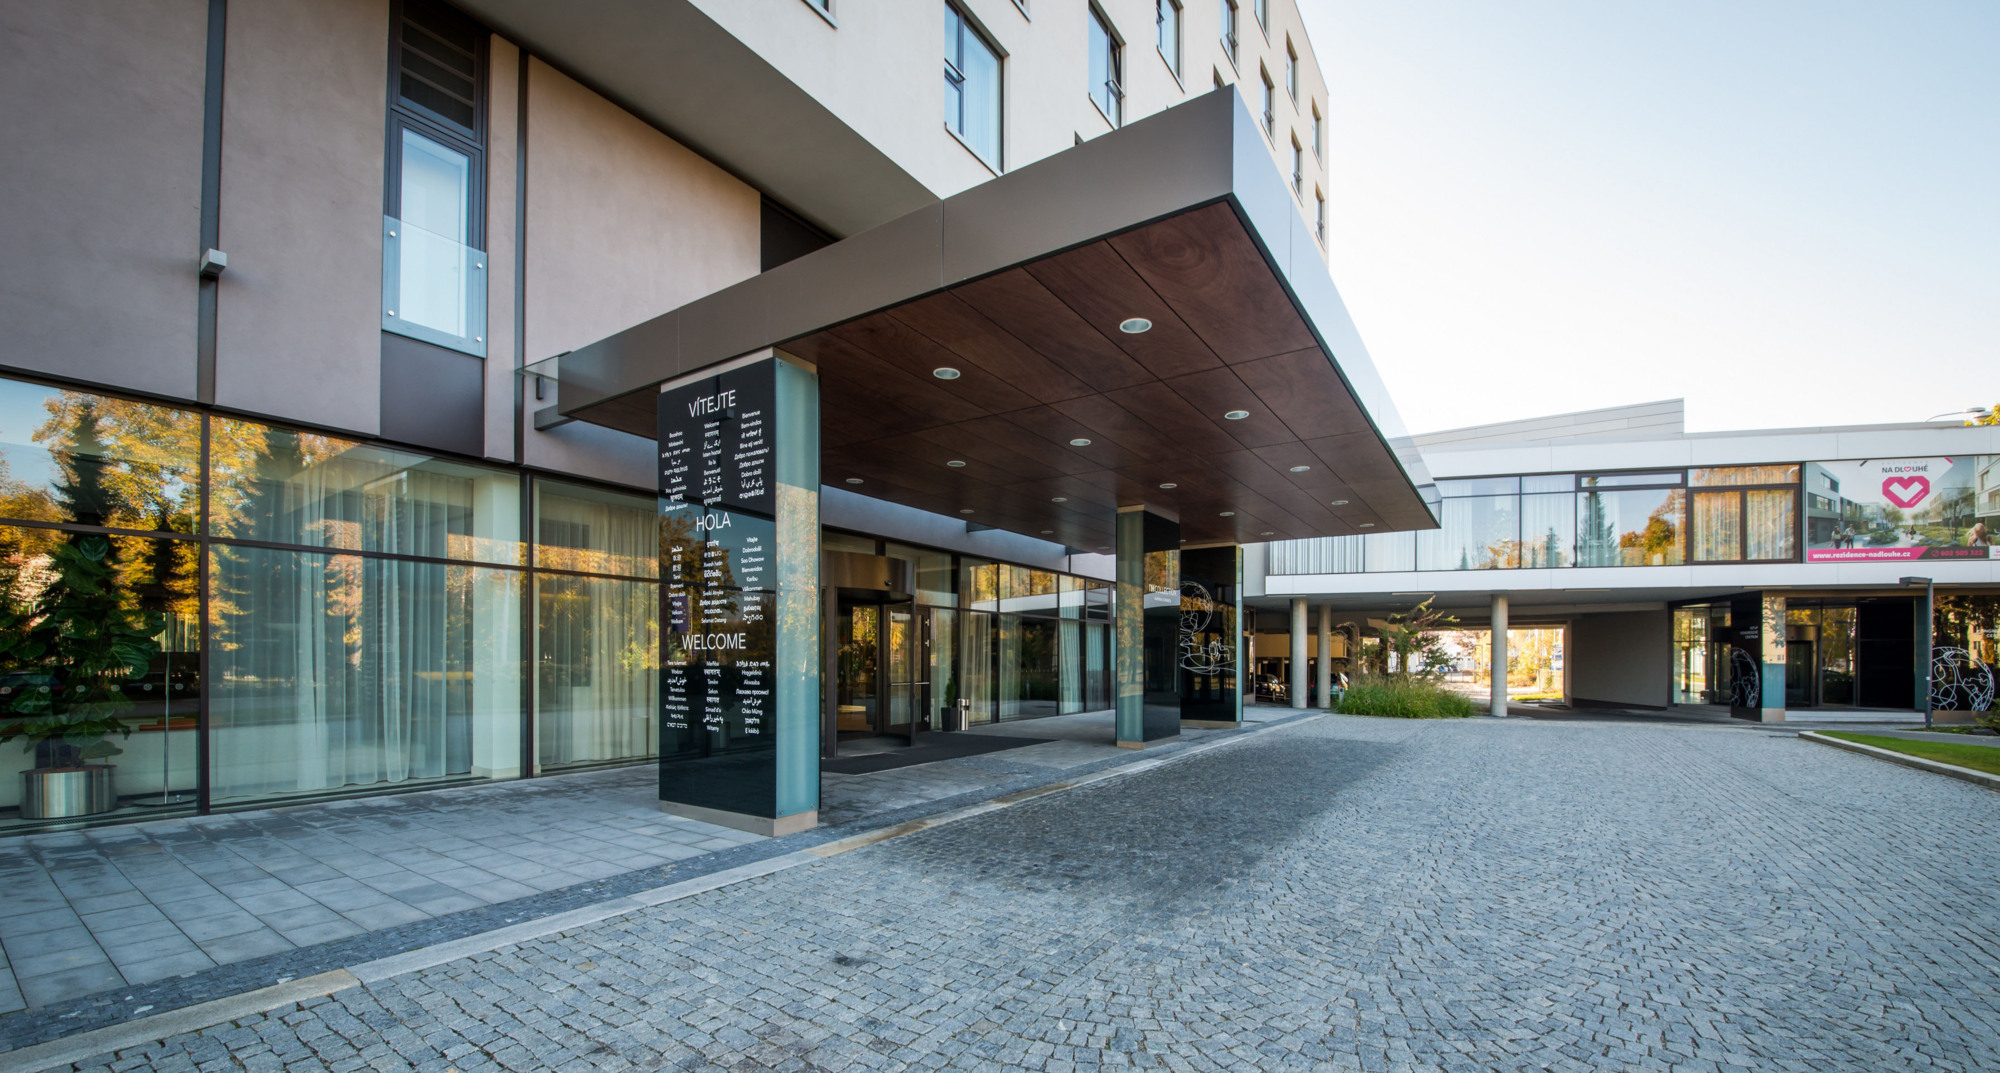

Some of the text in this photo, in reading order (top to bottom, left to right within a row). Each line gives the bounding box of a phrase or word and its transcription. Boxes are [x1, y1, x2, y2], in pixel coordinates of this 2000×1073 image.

[689, 389, 736, 418] VÍTEJTE
[696, 512, 731, 532] HOLA
[1813, 551, 1911, 559] www.rezidence-nadlouhe.cz
[682, 633, 746, 650] WELCOME
